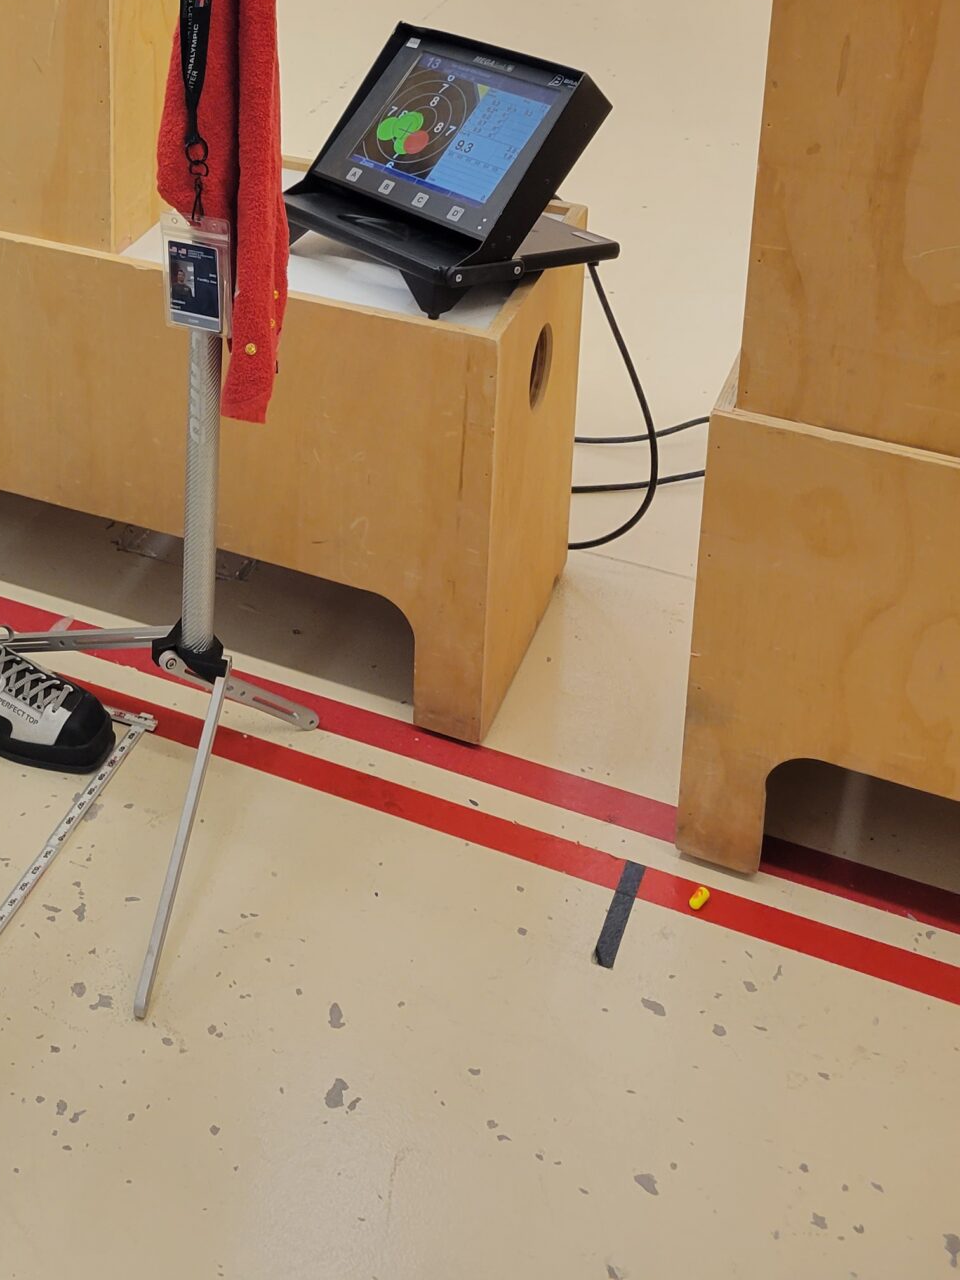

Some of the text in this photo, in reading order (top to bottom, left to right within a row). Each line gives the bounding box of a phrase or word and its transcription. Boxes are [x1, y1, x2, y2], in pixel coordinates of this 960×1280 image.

[426, 57, 441, 69] 13
[439, 83, 449, 93] 7
[430, 96, 439, 107] 8
[387, 106, 398, 116] 7
[434, 122, 456, 136] 8 7
[455, 140, 474, 153] 9.3
[351, 171, 358, 179] A
[417, 196, 424, 204] C
[452, 209, 459, 217] D
[24, 712, 39, 726] TOP
[43, 851, 52, 859] 54
[32, 866, 40, 875] 53
[19, 883, 28, 891] 52
